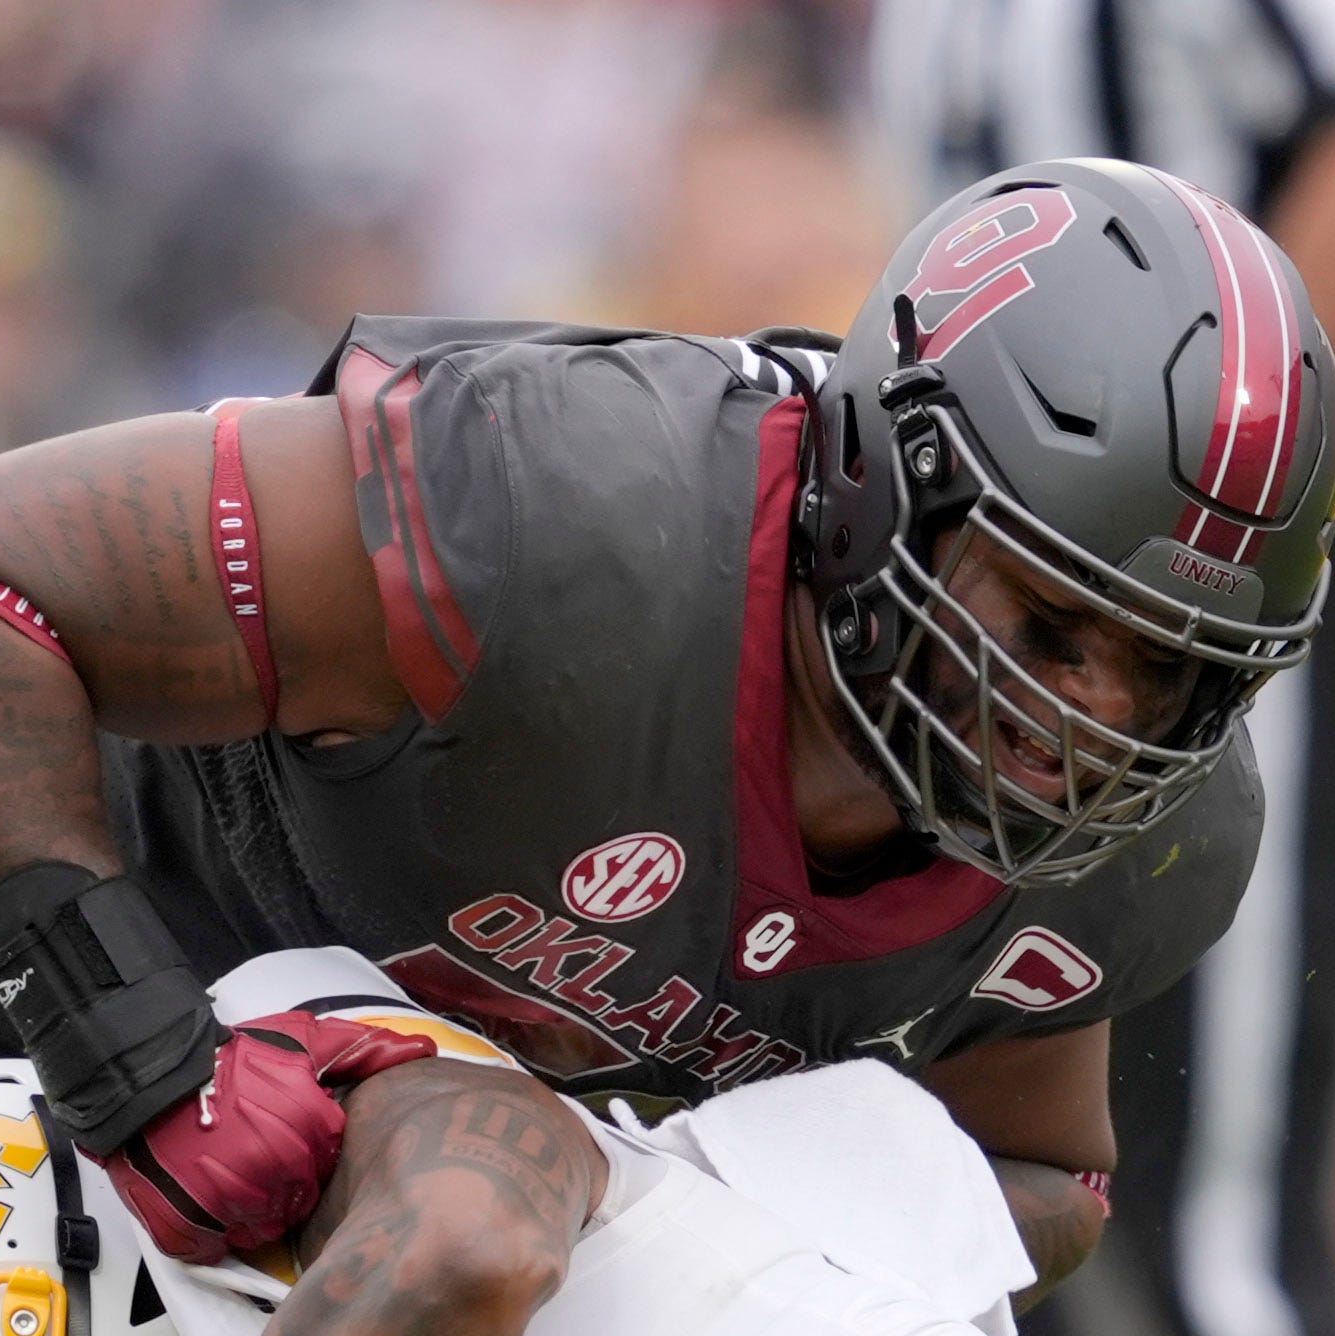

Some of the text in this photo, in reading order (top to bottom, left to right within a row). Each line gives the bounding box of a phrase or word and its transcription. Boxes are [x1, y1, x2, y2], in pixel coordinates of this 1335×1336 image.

[219, 498, 258, 616] JORDAN
[1169, 550, 1246, 597] UNITY
[568, 836, 680, 919] SEC
[743, 911, 797, 973] OU
[448, 893, 814, 1095] OKLAHO
